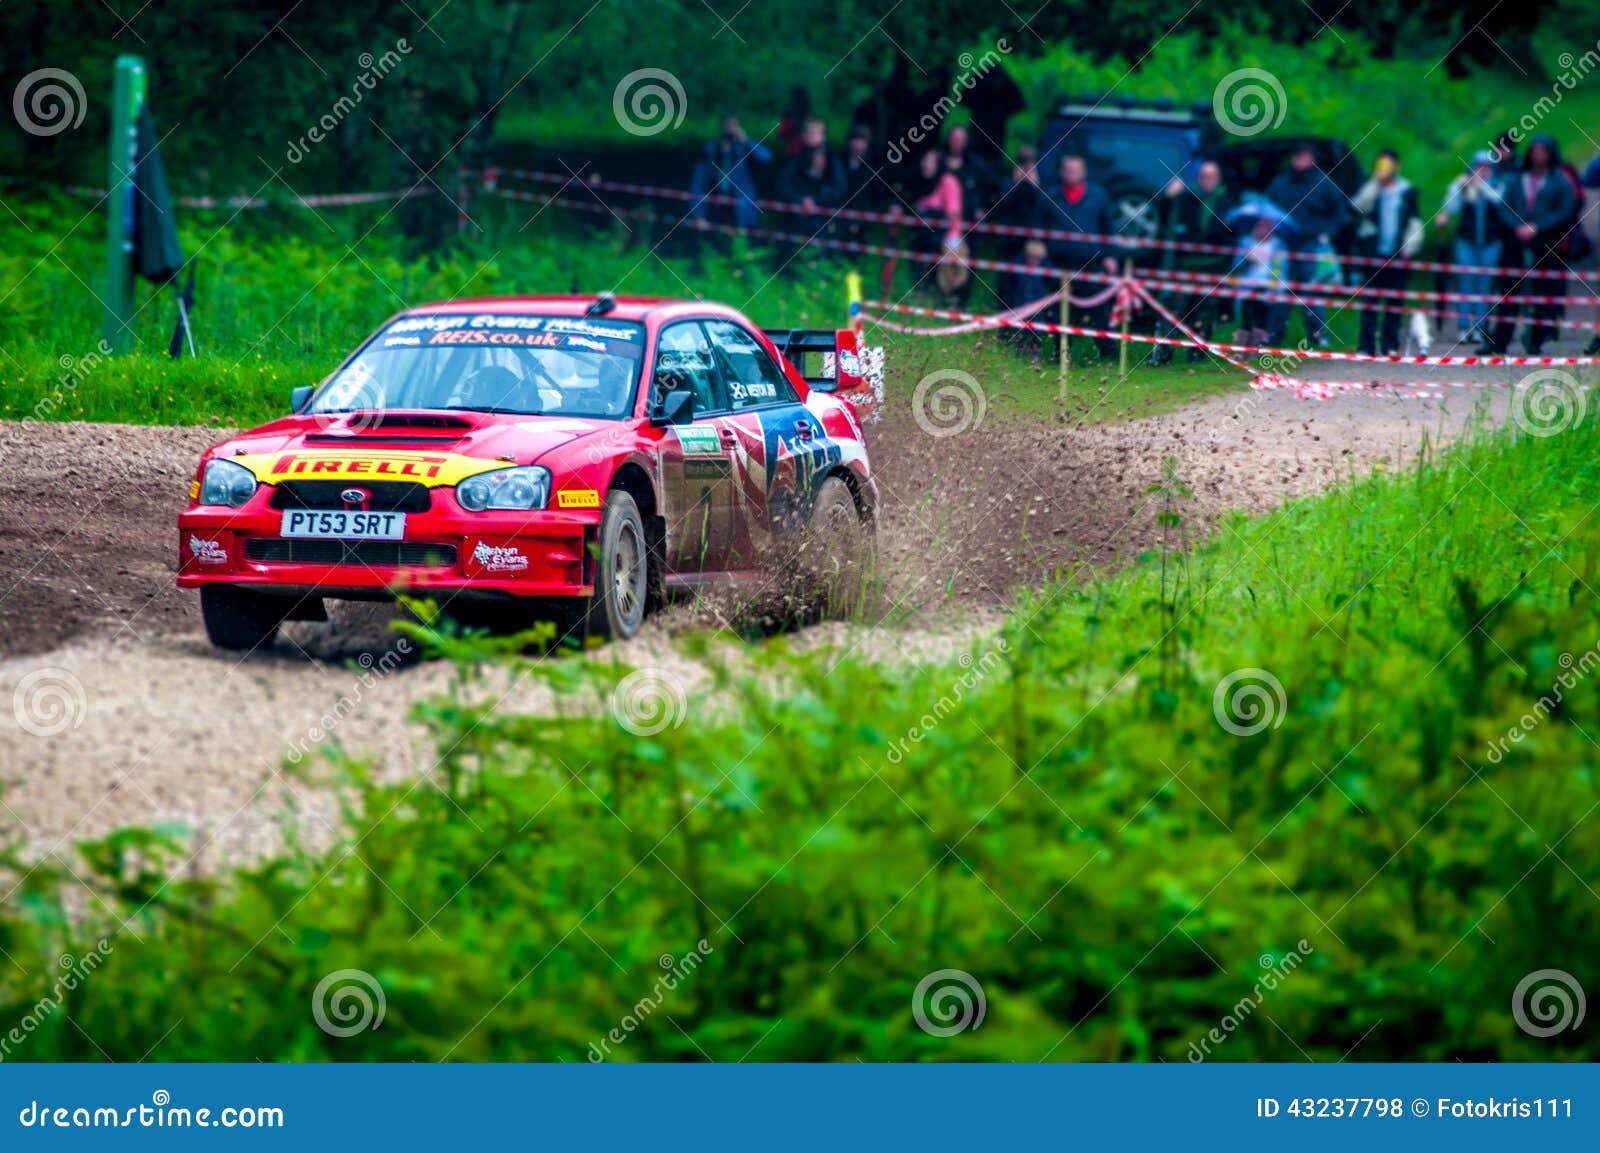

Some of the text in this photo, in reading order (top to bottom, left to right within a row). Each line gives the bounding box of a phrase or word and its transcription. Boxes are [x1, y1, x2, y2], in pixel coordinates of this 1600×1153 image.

[271, 455, 447, 478] PIRELLI
[290, 513, 396, 535] PT53 SRT
